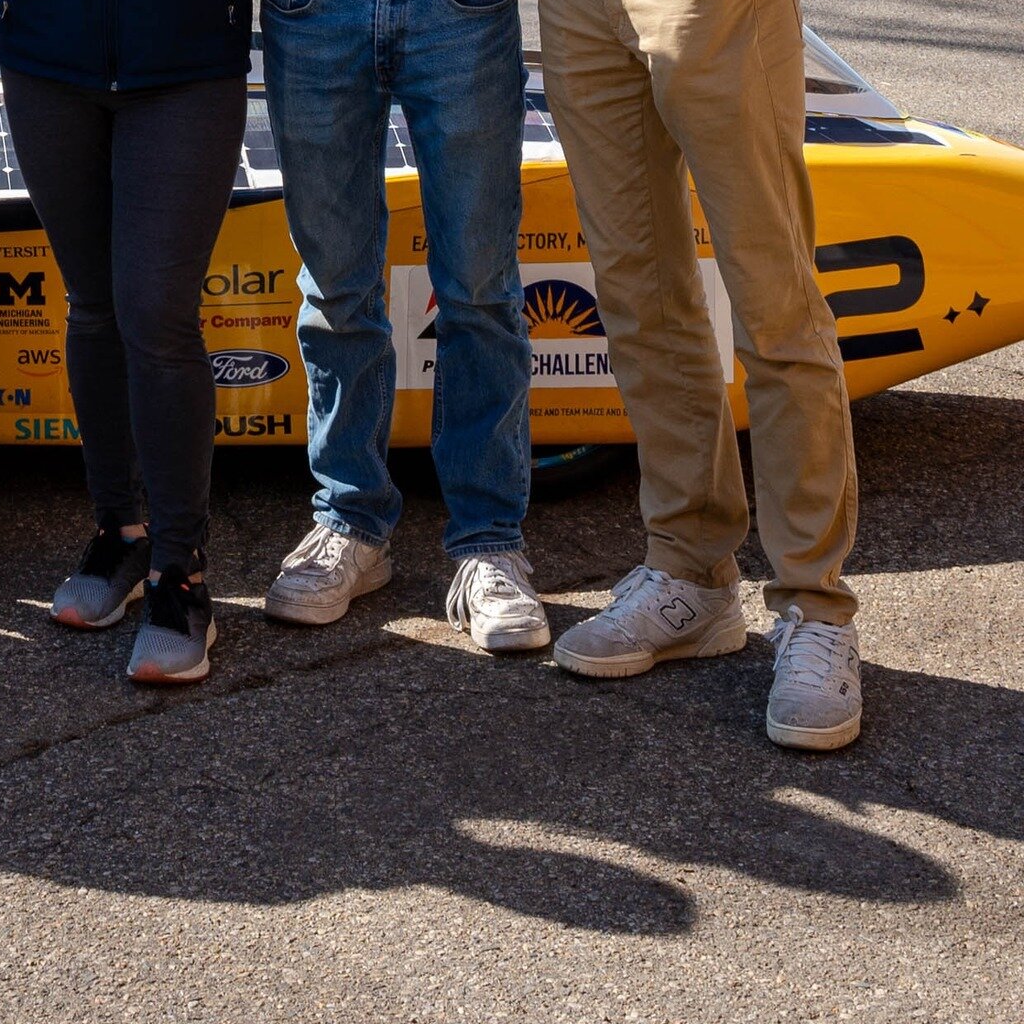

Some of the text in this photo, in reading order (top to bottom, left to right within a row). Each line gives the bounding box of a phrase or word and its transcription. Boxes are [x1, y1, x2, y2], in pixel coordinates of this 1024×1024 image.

[202, 264, 284, 296] olar
[0, 309, 43, 318] MICHIGAN
[210, 314, 293, 330] Company
[17, 349, 62, 365] aws
[530, 352, 614, 376] CHALLEN
[212, 355, 269, 381] Ford
[544, 408, 560, 416] AND
[562, 407, 580, 416] TEAM
[582, 407, 605, 416] MAIZE
[606, 407, 622, 416] AND
